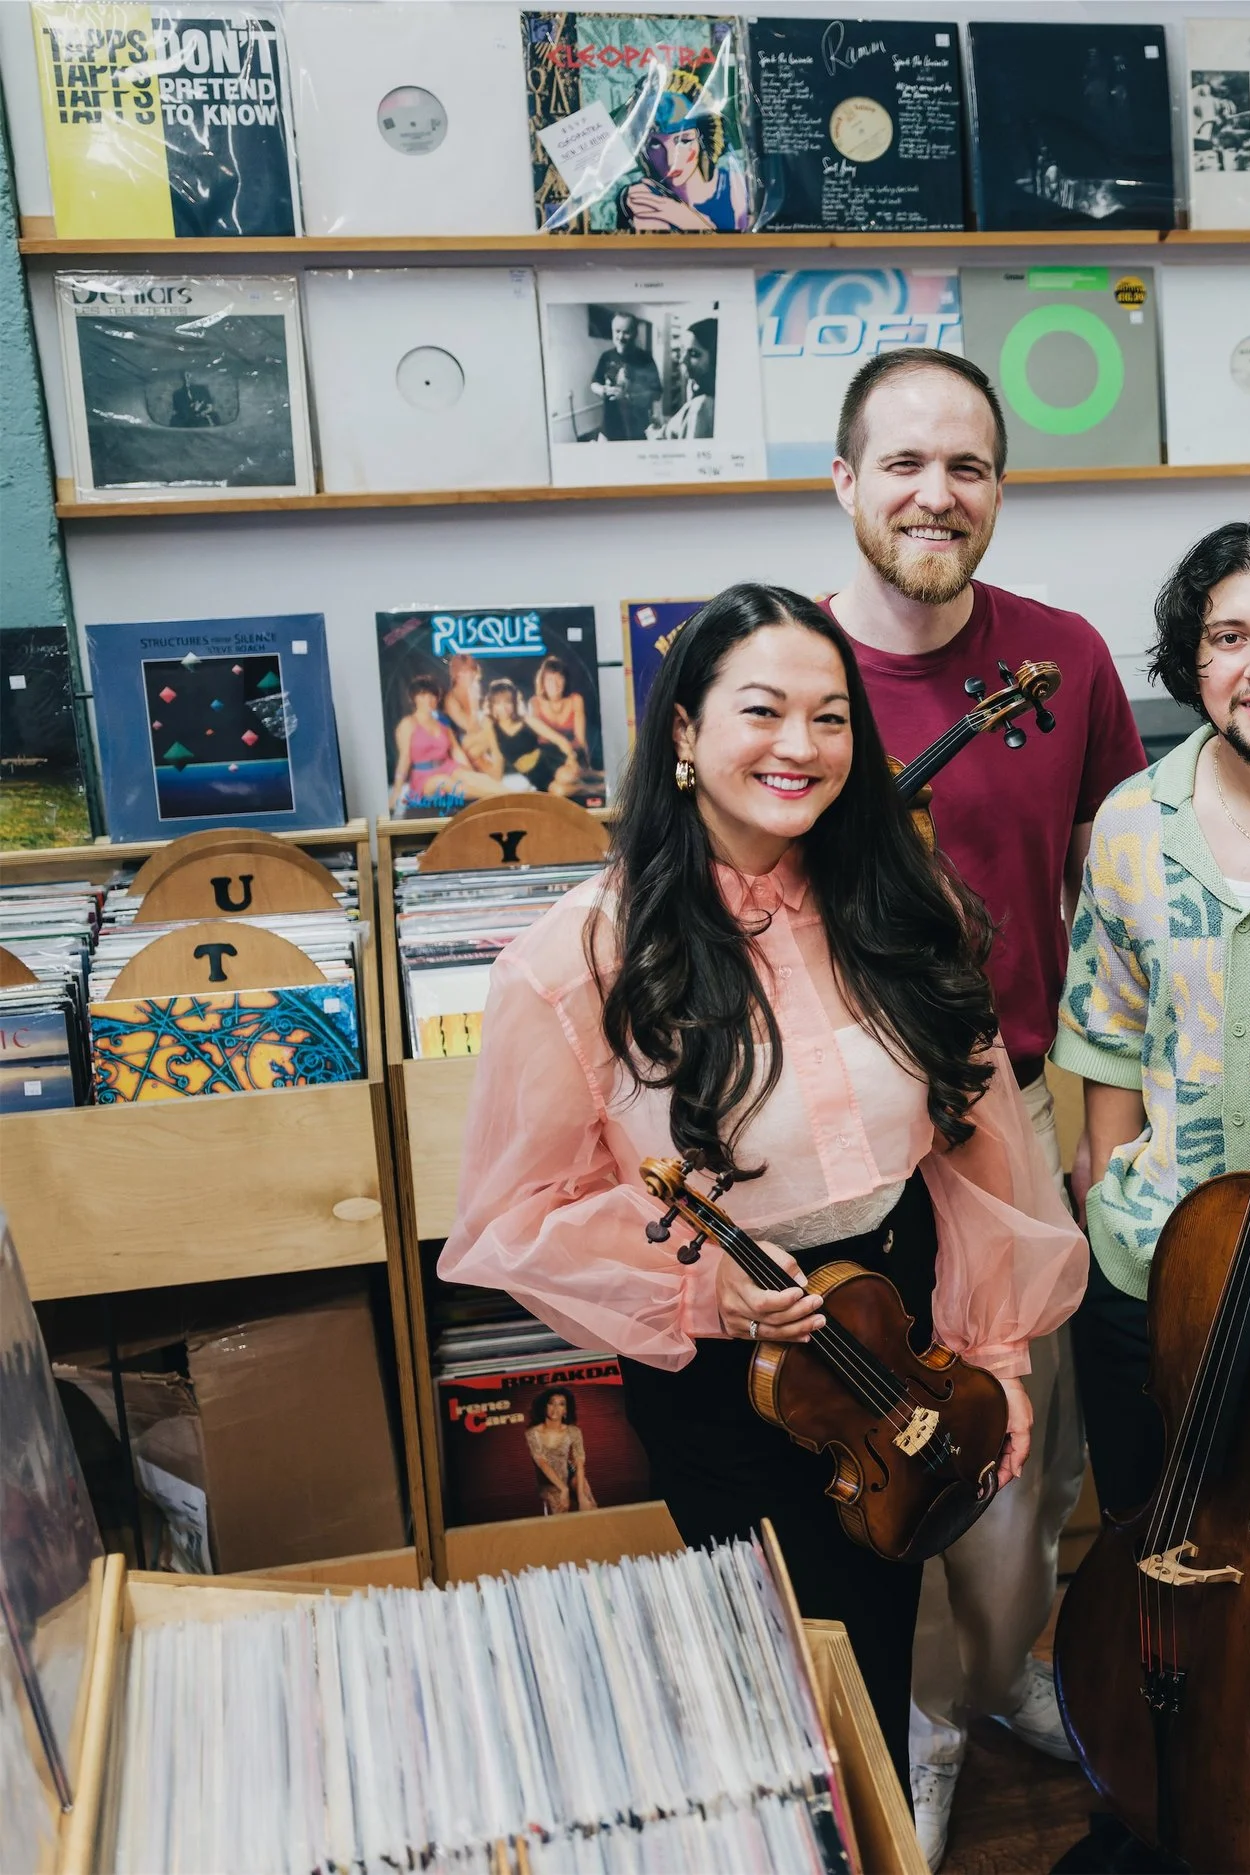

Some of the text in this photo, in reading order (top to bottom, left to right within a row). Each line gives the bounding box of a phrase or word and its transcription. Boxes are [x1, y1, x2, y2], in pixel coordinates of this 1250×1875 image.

[153, 28, 277, 75] DON'T
[546, 43, 718, 69] CLEOPATRA
[158, 78, 277, 101] PRETEND
[161, 104, 279, 127] TO KNOW
[762, 313, 960, 358] LOFT
[140, 634, 209, 649] STRUCTURES
[234, 632, 277, 645] SILENCE
[488, 830, 528, 863] Y
[209, 875, 254, 912] U
[193, 943, 238, 982] T
[449, 1398, 511, 1421] Irene
[464, 1411, 525, 1433] Cara
